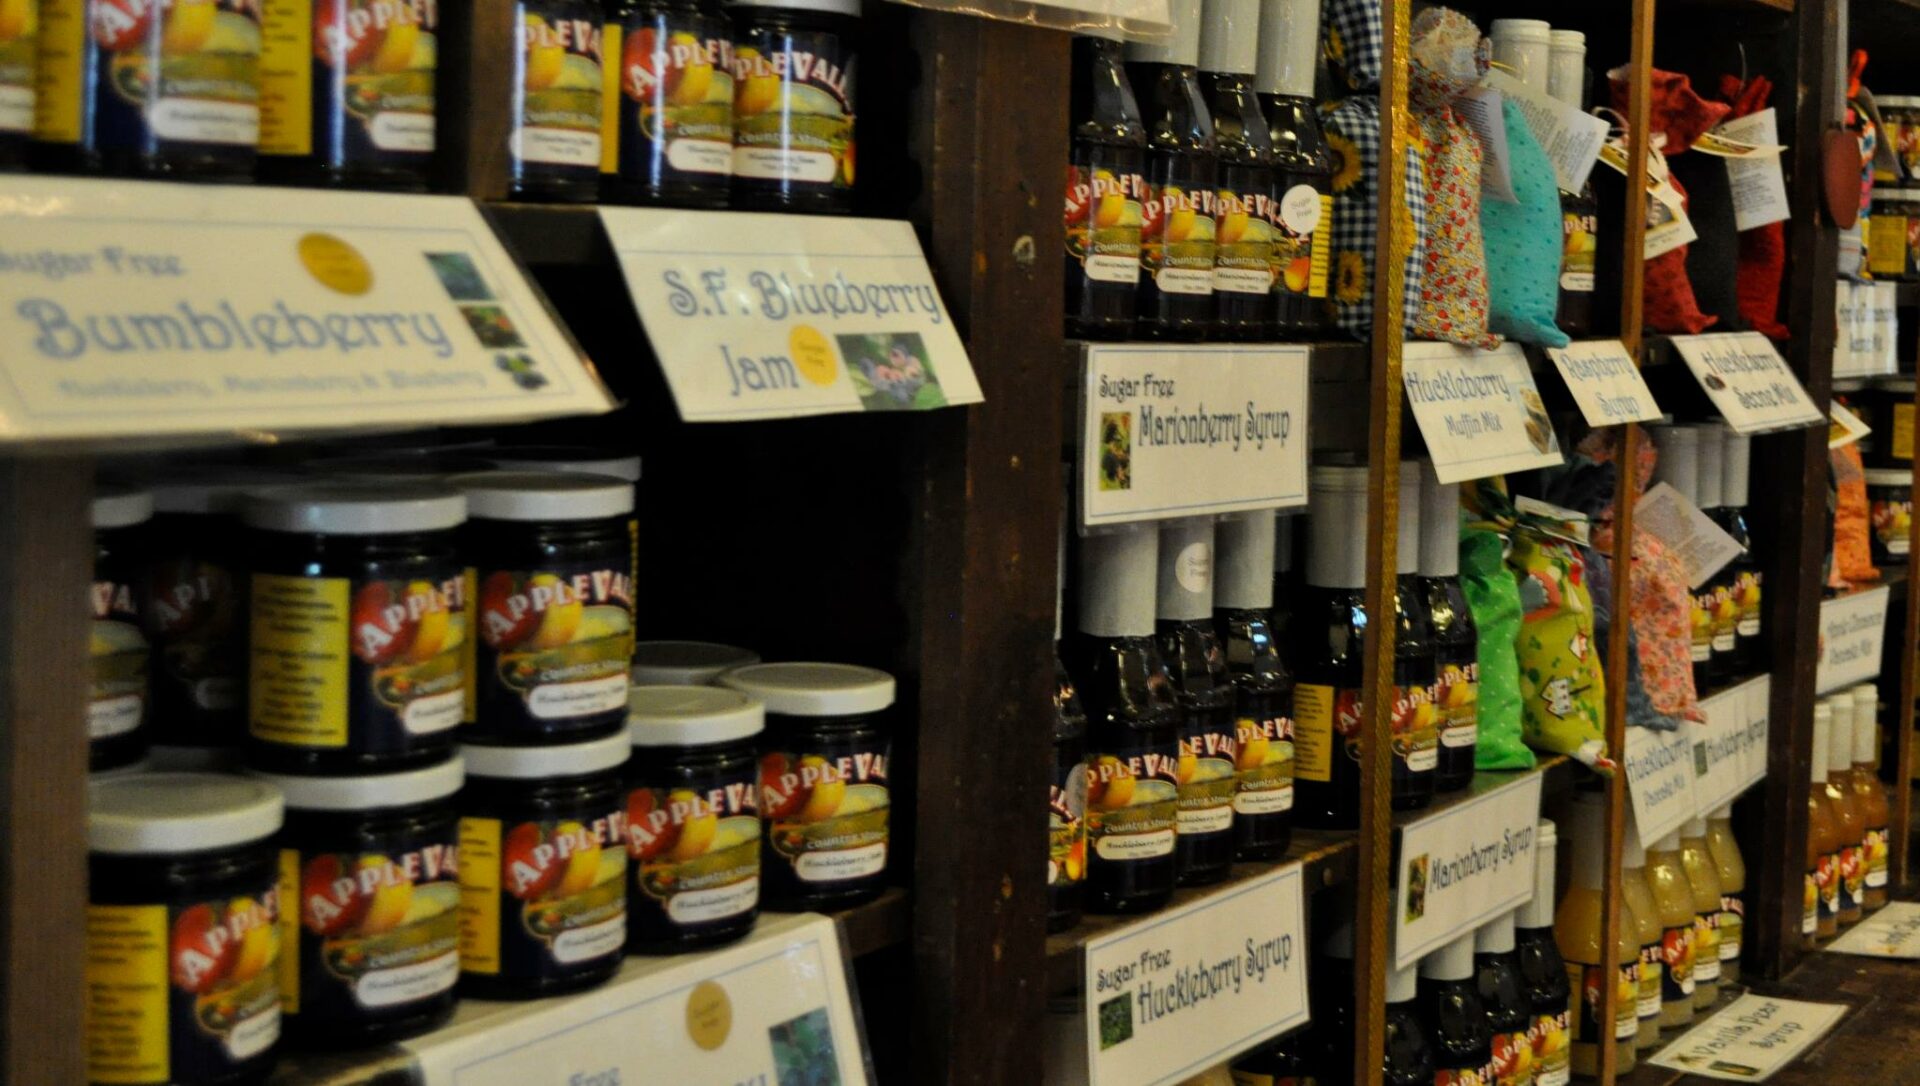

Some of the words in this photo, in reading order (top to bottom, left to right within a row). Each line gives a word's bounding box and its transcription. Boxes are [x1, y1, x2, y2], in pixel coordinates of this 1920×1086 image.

[0, 247, 95, 279] ugar
[751, 268, 943, 324] Blueberry
[17, 299, 455, 360] Bumbleberry
[720, 345, 800, 396] Jam
[1561, 352, 1637, 382] Raspberry
[1701, 348, 1784, 375] Huckleberry
[1099, 374, 1139, 403] Sugar
[1143, 373, 1175, 397] Free
[1406, 368, 1513, 404] Huckleberry
[1444, 412, 1482, 440] Muffin
[1482, 411, 1504, 434] Mix
[1595, 392, 1641, 421] Syrup
[1138, 402, 1242, 452] Marionberry
[1246, 401, 1290, 449] Syrup
[1430, 839, 1499, 894] Marionberry
[1502, 826, 1532, 864] Syrup
[1096, 962, 1137, 992] Sugar
[1140, 949, 1171, 974] Free
[1138, 954, 1241, 1025] Huckleberry
[1246, 932, 1292, 983] Syrup
